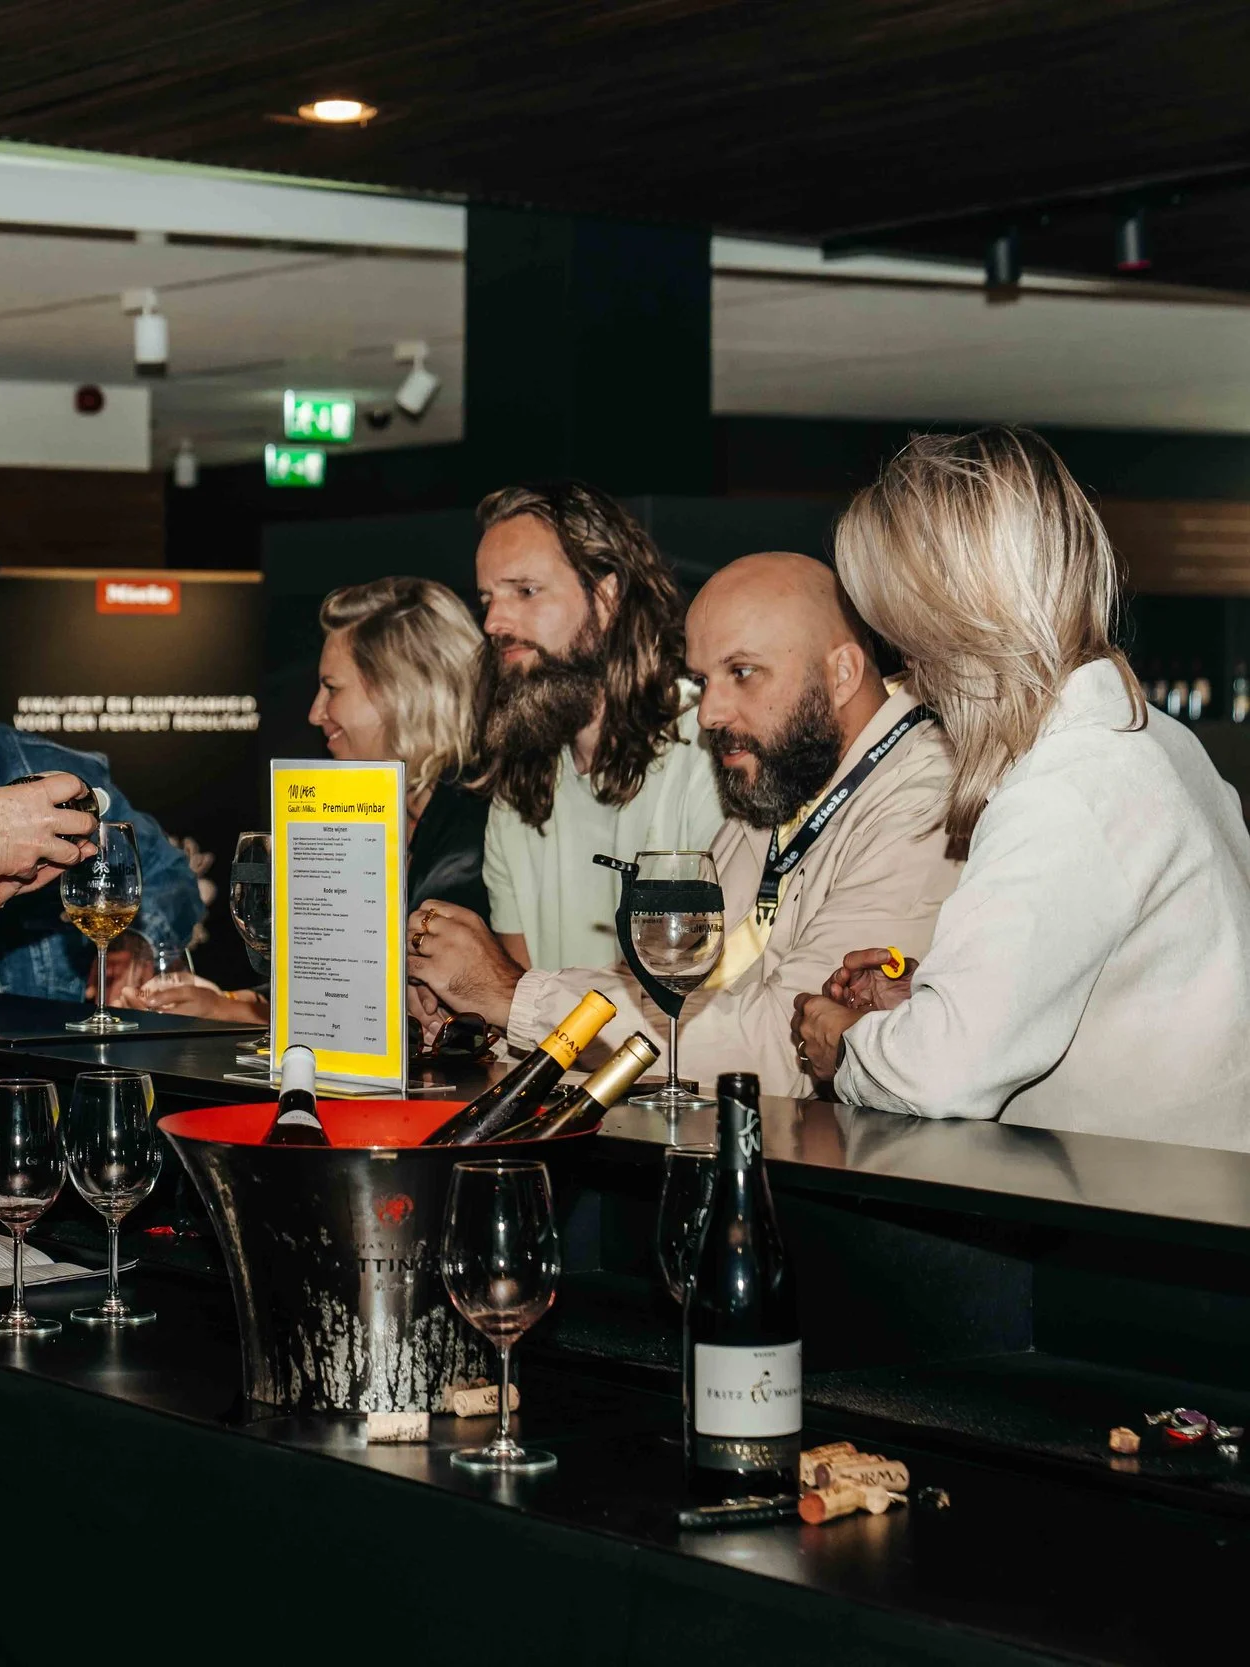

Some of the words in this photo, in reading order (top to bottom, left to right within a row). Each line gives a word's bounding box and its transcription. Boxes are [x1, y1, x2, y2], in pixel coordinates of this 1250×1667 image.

[105, 583, 173, 605] Miele
[868, 721, 910, 763] Miele
[322, 803, 355, 813] Premium
[356, 803, 385, 816] Wijnbar
[808, 788, 849, 833] Miele
[334, 887, 348, 895] wijnen
